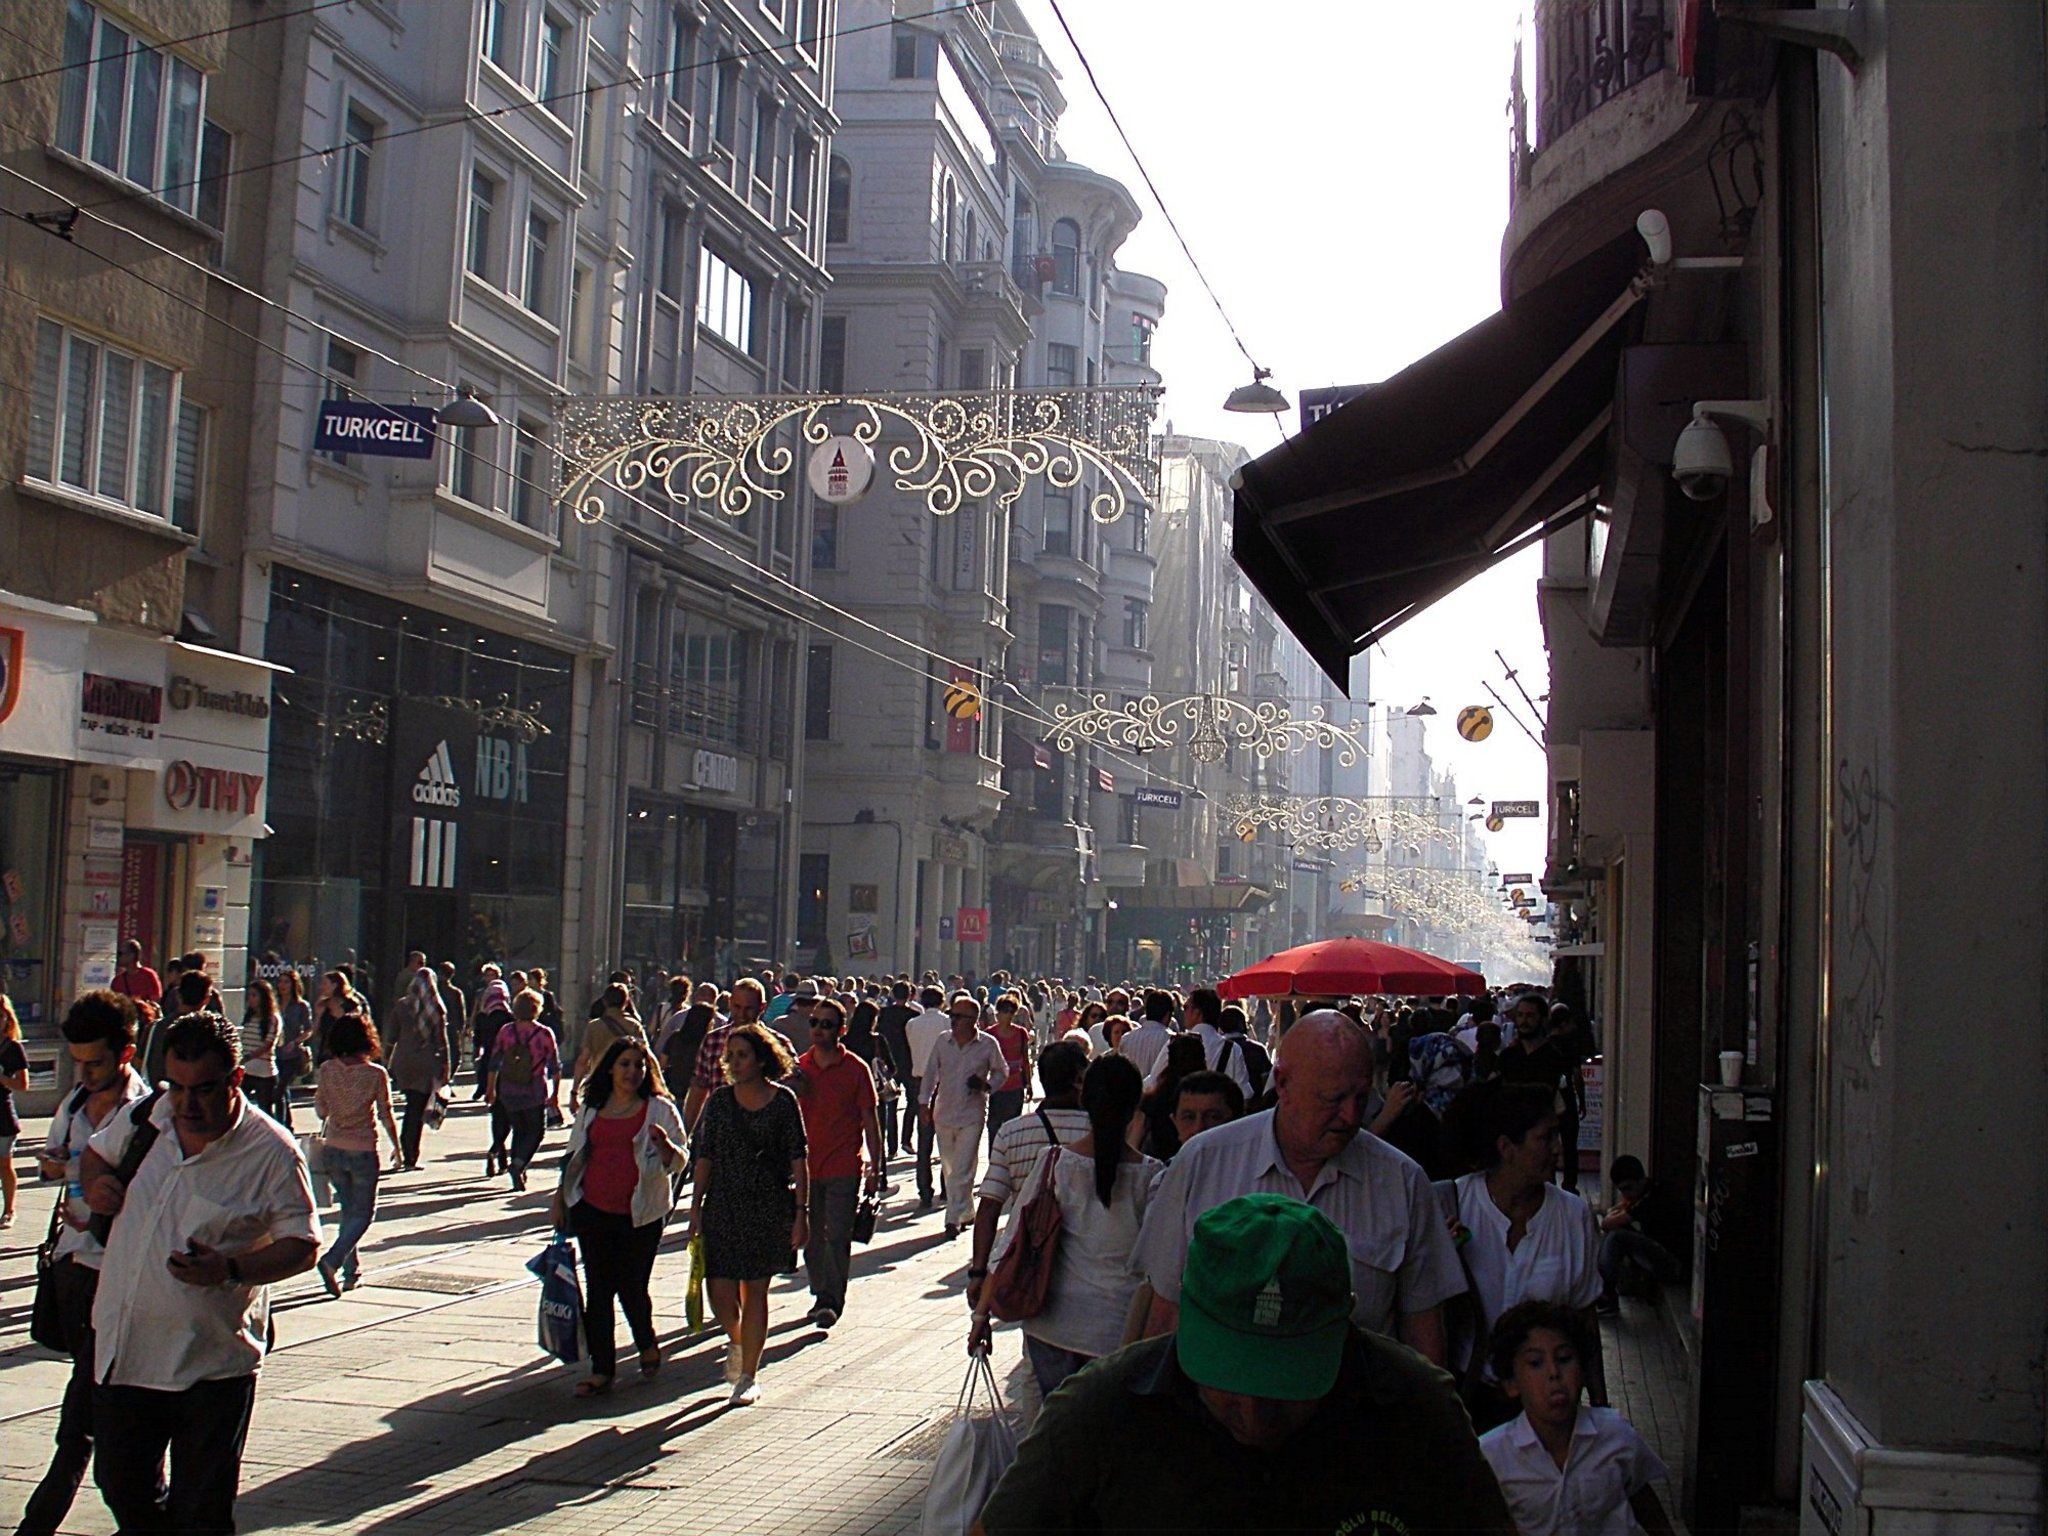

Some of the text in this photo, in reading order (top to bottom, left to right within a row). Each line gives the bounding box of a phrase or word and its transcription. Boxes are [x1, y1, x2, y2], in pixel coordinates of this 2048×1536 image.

[324, 415, 424, 443] TURKCELL
[475, 735, 528, 803] NBA
[196, 766, 264, 815] THY
[413, 781, 460, 807] adidas
[1137, 792, 1178, 805] TURKCELL
[1494, 805, 1536, 814] TURKCELL
